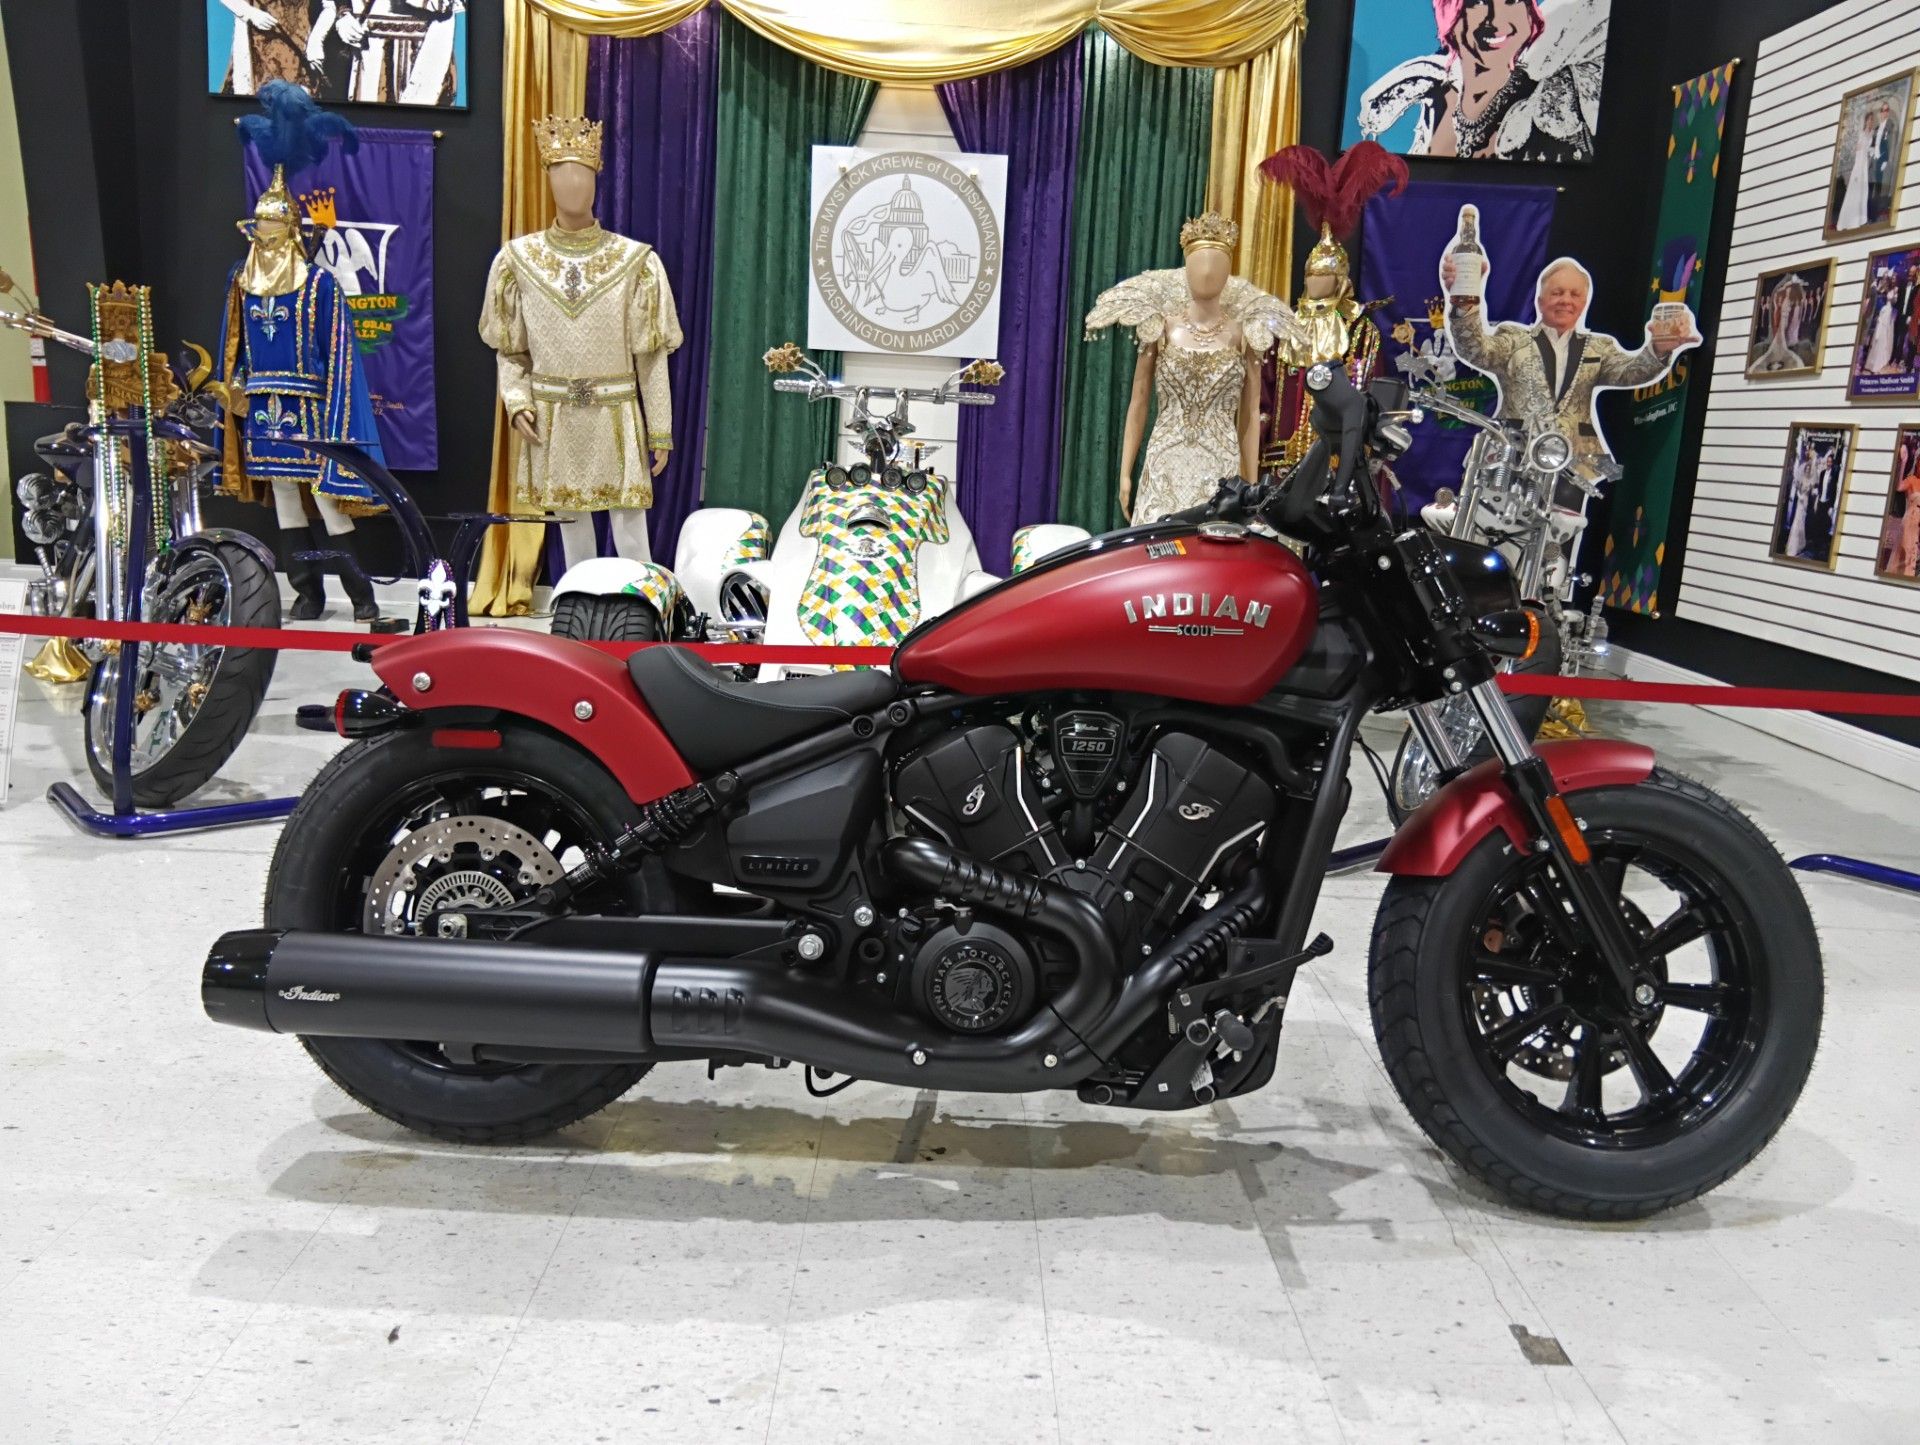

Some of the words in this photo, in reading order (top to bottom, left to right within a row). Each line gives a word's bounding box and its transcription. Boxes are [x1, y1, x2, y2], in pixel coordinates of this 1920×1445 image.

[871, 154, 923, 174] KREWE
[927, 162, 942, 173] of
[821, 166, 870, 222] MYSTICK
[943, 166, 997, 261] LOUISIANIANS
[816, 225, 831, 250] The
[347, 296, 397, 310] NGTON
[819, 271, 905, 349] WASHINGTON
[909, 322, 961, 349] MARDI
[959, 280, 993, 323] GRAS
[355, 329, 377, 339] ALL
[1123, 592, 1272, 629] INDIAN
[1176, 624, 1216, 636] SCOUT
[1072, 740, 1107, 752] 1250
[748, 862, 809, 871] LIMITED
[933, 956, 953, 1011] INDIAN
[957, 949, 1012, 1015] MOTORCYCLE
[282, 985, 336, 1002] Indian
[955, 1017, 986, 1028] 1901
